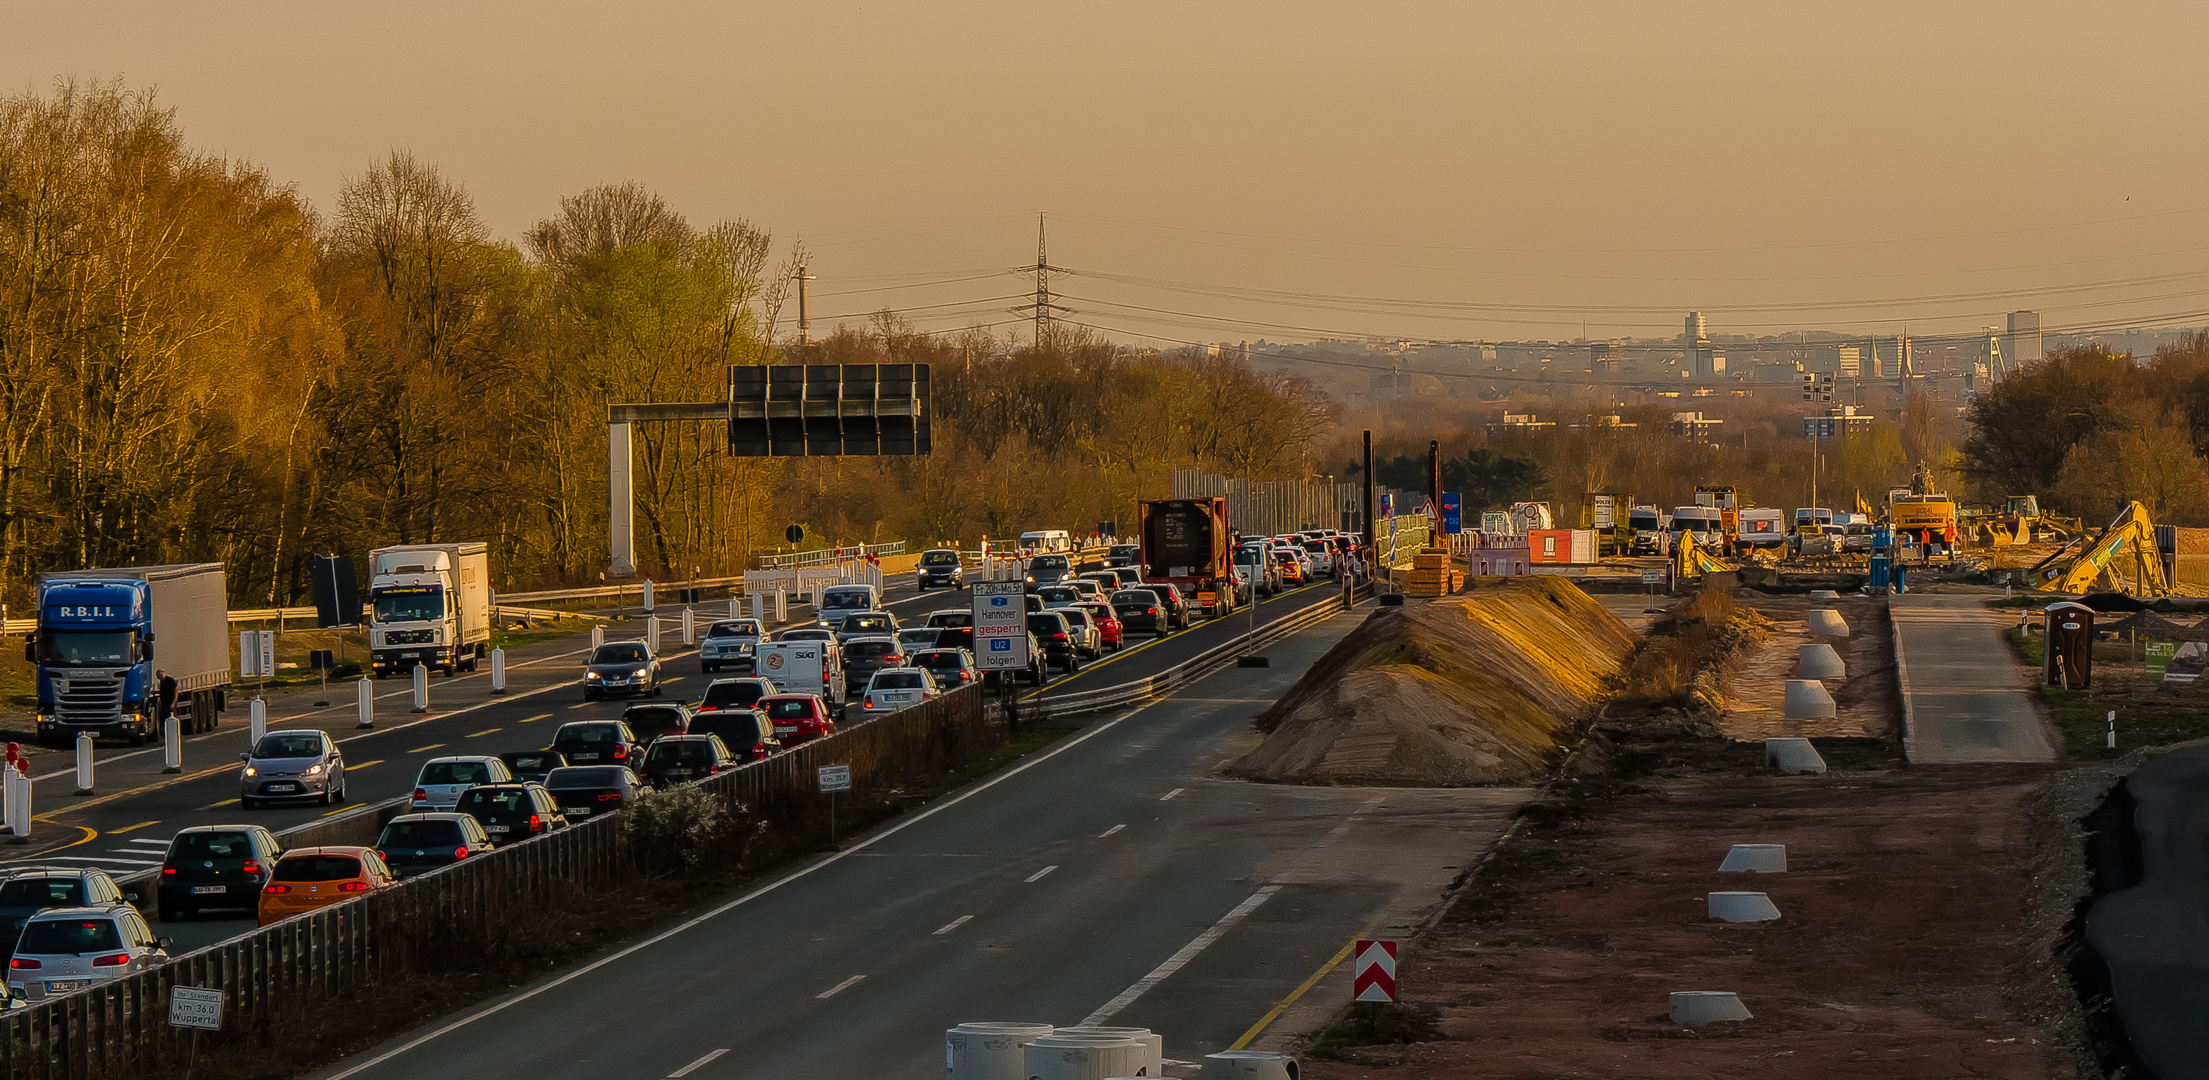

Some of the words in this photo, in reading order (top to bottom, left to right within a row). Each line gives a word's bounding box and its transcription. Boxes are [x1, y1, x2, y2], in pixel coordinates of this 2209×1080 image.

[2047, 568, 2058, 579] CAT
[996, 597, 1002, 605] 2
[982, 608, 1016, 620] Hannover
[979, 624, 1021, 635] gesperrt
[994, 641, 1006, 649] U2
[795, 651, 815, 659] SIXT
[986, 655, 1016, 666] folgen
[69, 670, 106, 678] SCANIA
[178, 1003, 192, 1012] km
[172, 1012, 219, 1025] Wuppertal
